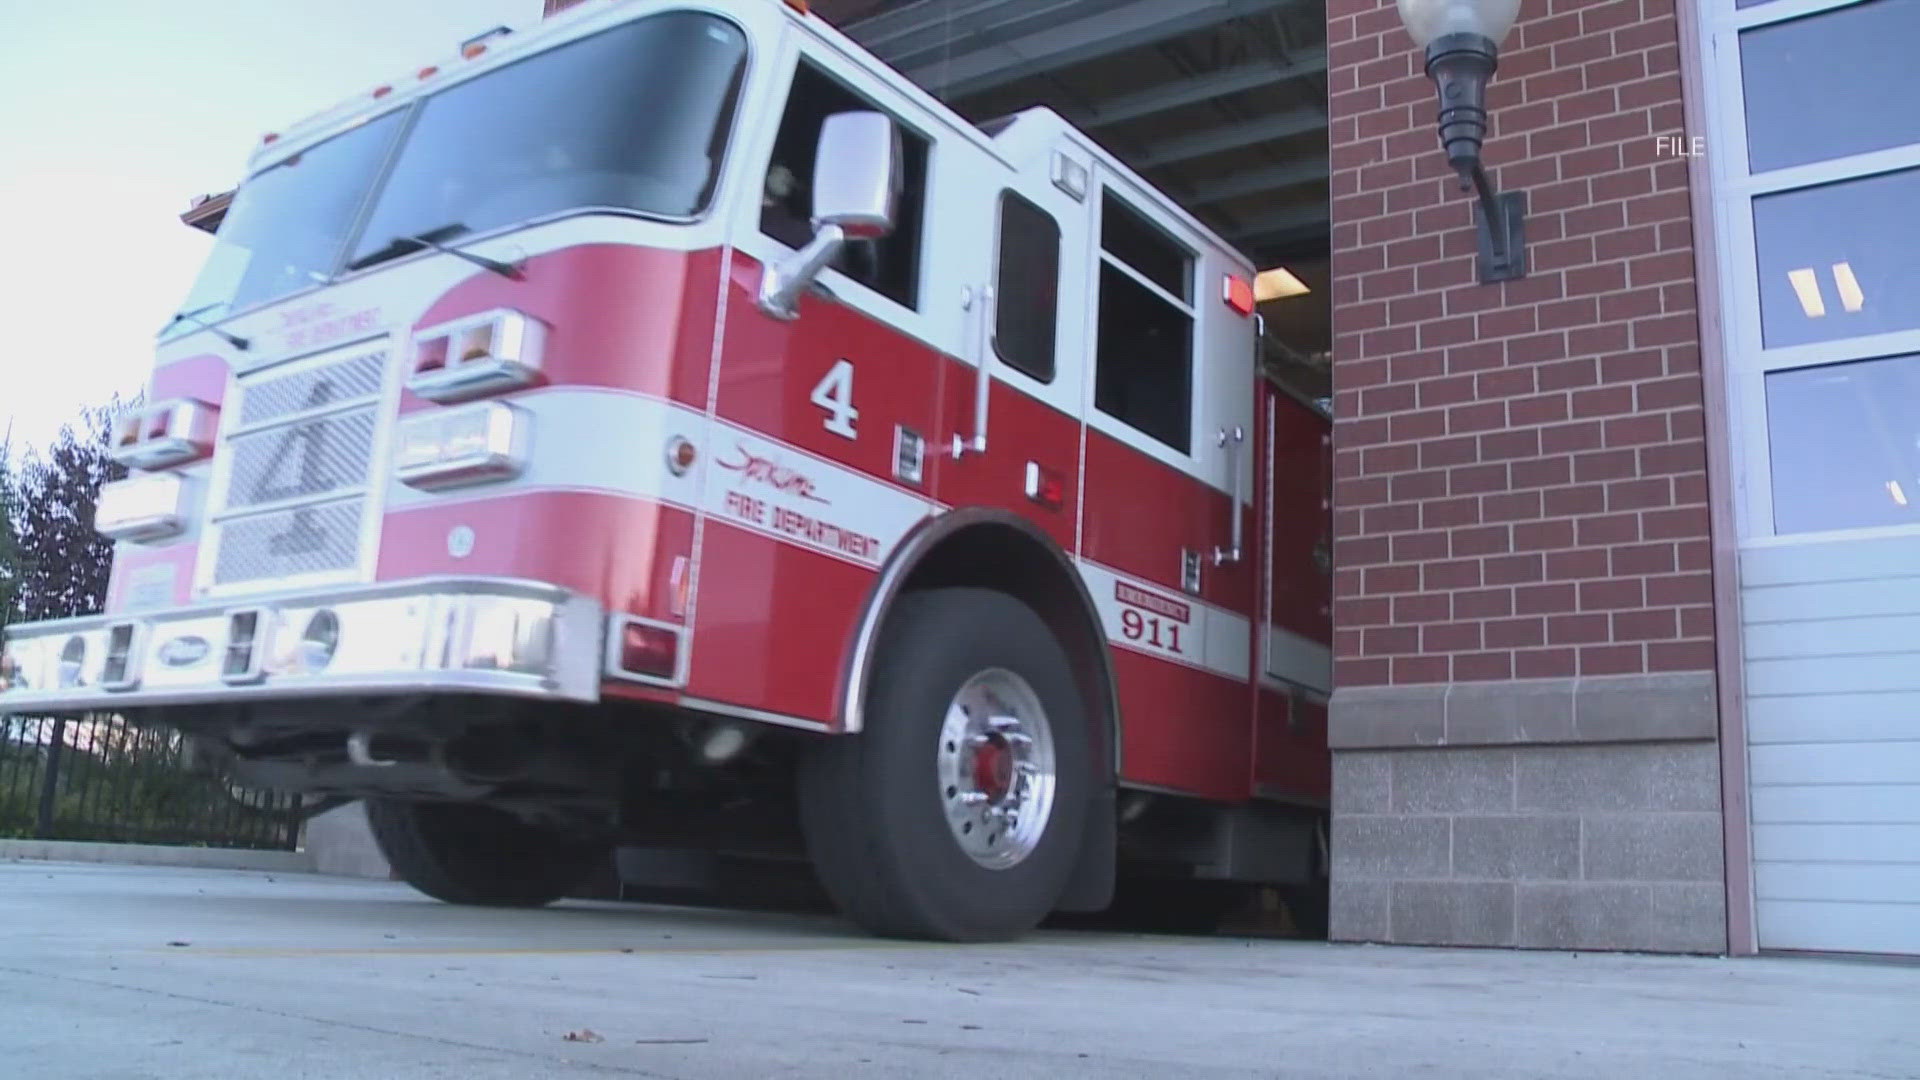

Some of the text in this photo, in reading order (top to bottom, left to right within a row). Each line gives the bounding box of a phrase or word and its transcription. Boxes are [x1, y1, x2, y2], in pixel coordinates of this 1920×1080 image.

[809, 358, 859, 441] 4
[252, 378, 338, 557] 4
[726, 490, 880, 560] FIRE DEPARTMENT
[1121, 608, 1183, 653] 911
